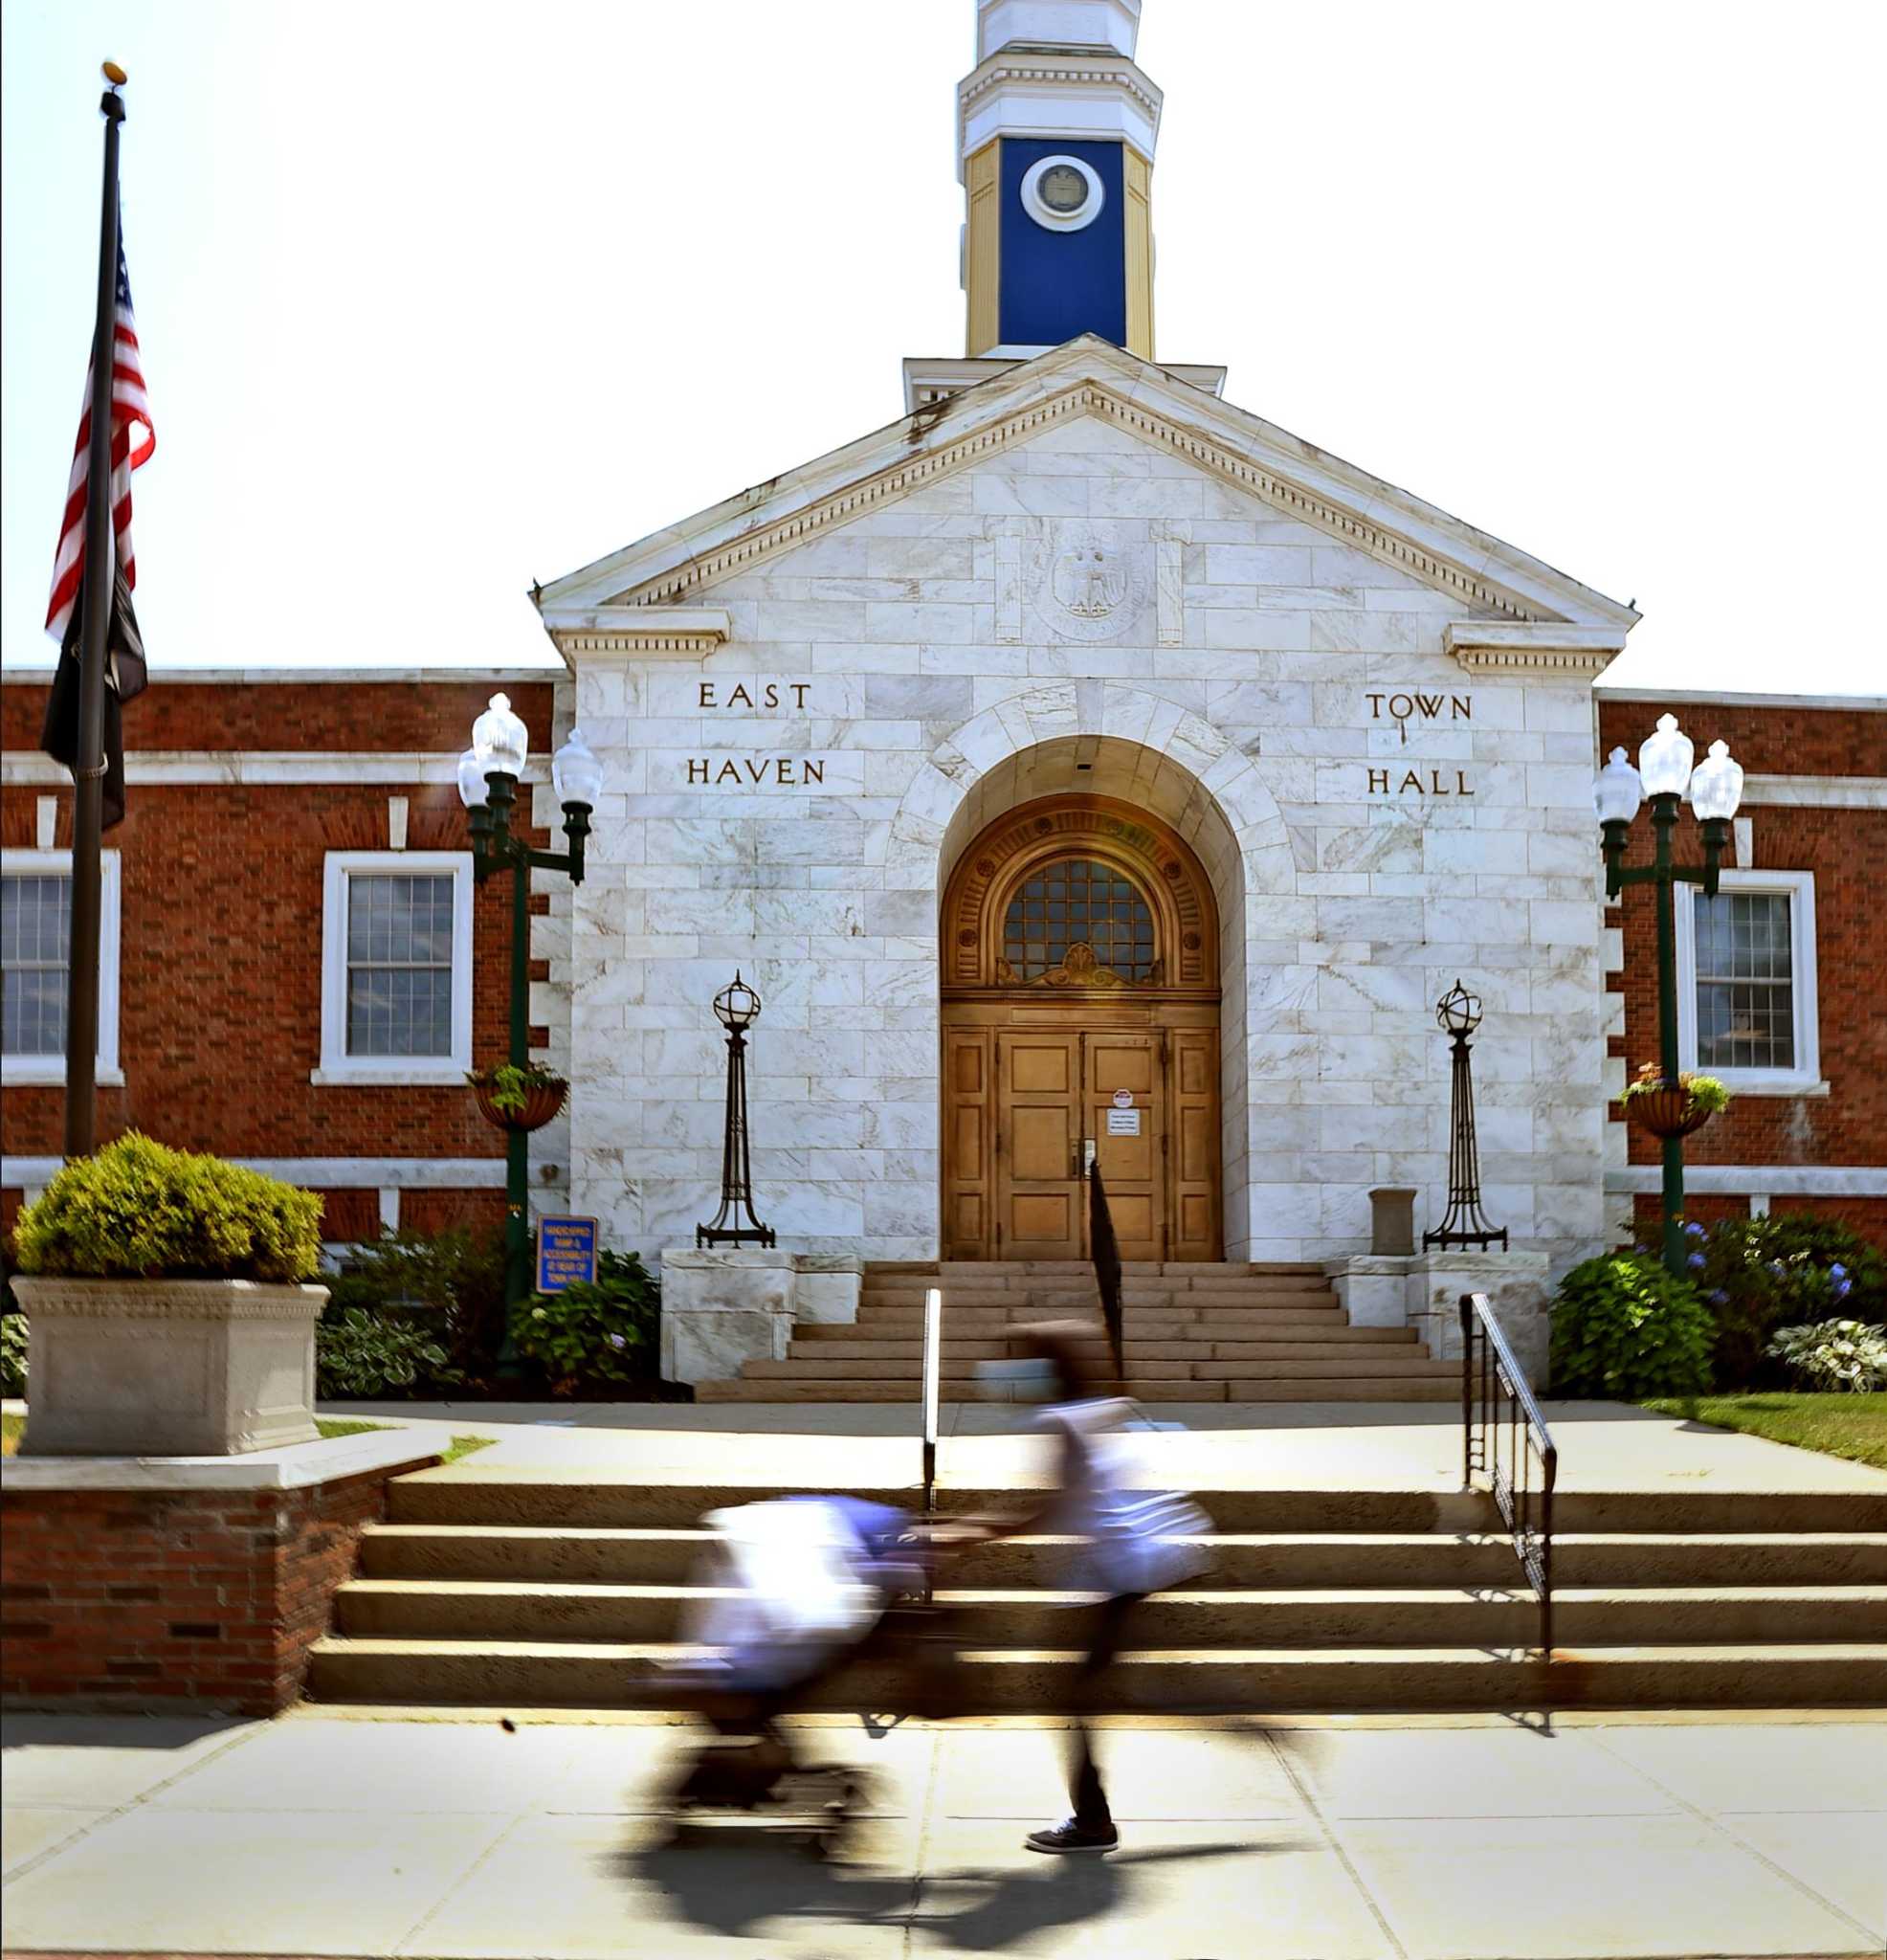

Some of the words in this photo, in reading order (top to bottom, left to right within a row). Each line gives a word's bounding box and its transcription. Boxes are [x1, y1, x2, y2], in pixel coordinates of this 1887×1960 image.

[699, 682, 811, 709] EAST
[1365, 694, 1472, 720] TOWN
[687, 758, 825, 785] HAVEN
[1367, 768, 1475, 796] HALL
